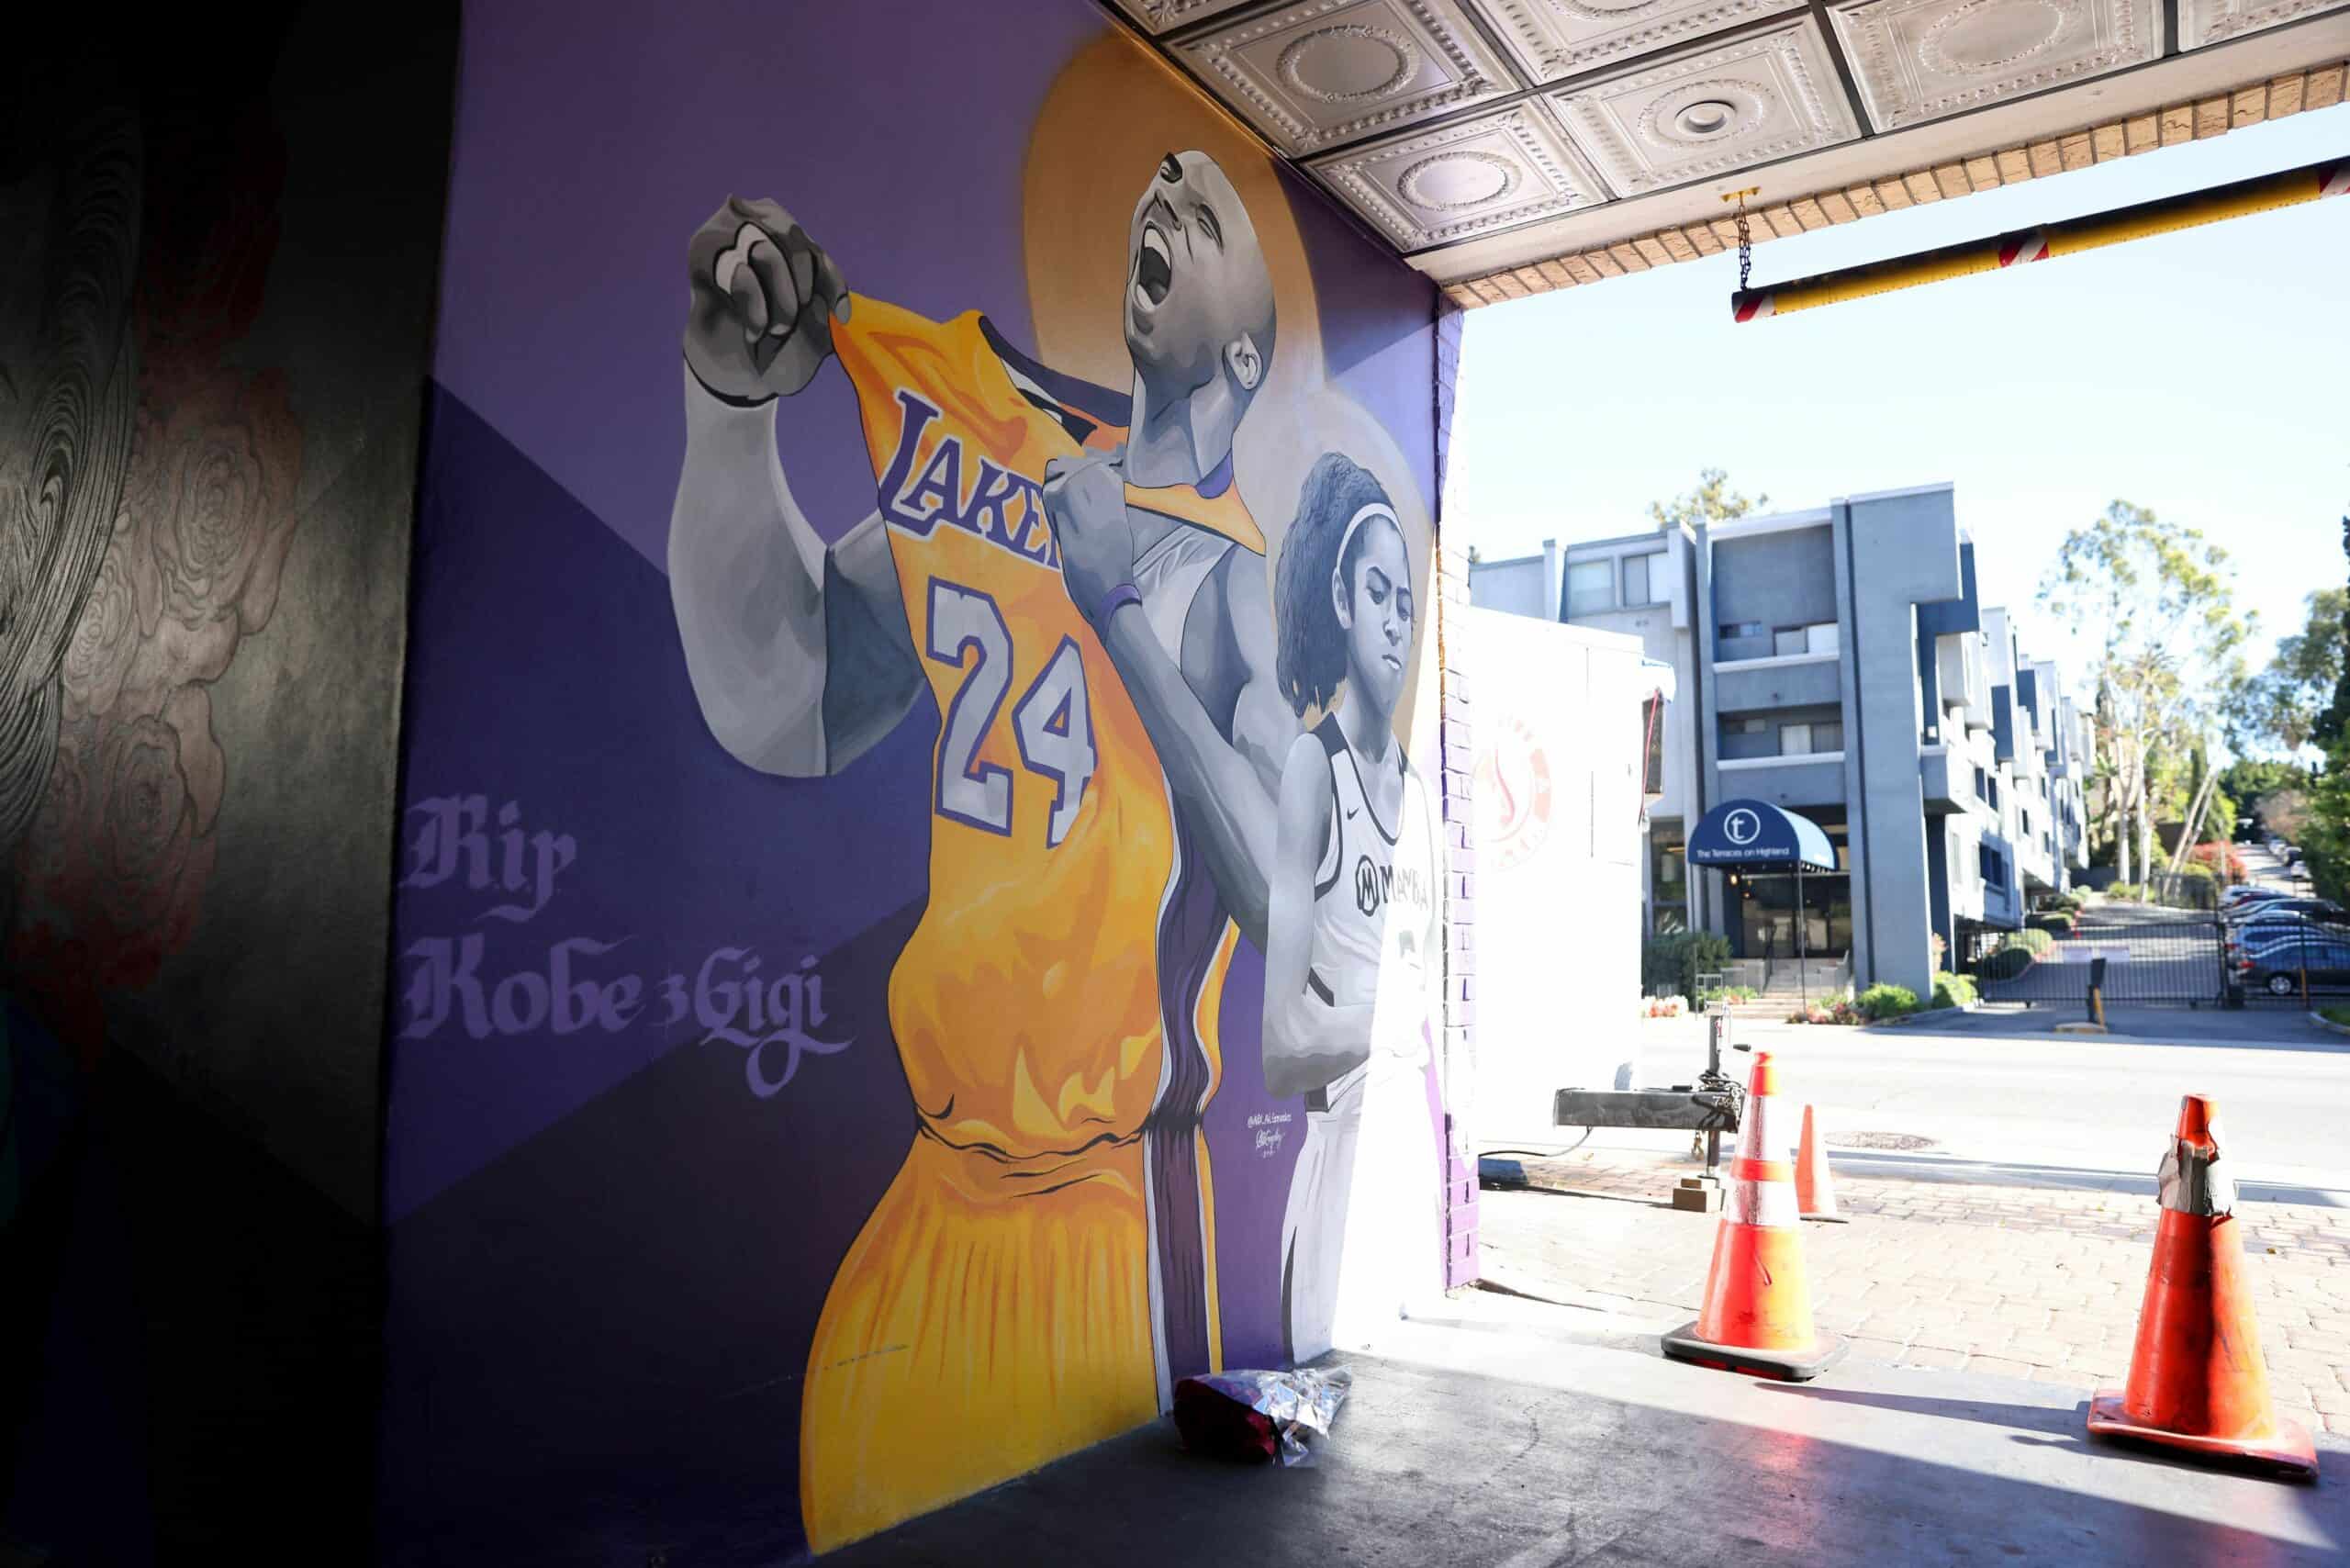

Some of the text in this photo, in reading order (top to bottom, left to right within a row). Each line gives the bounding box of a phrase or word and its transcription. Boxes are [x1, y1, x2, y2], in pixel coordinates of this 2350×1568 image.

[926, 575, 1100, 850] 24
[1696, 847, 1790, 858] The Terraces on Highland
[397, 933, 644, 1039] Kobe
[695, 946, 857, 1098] Gigi
